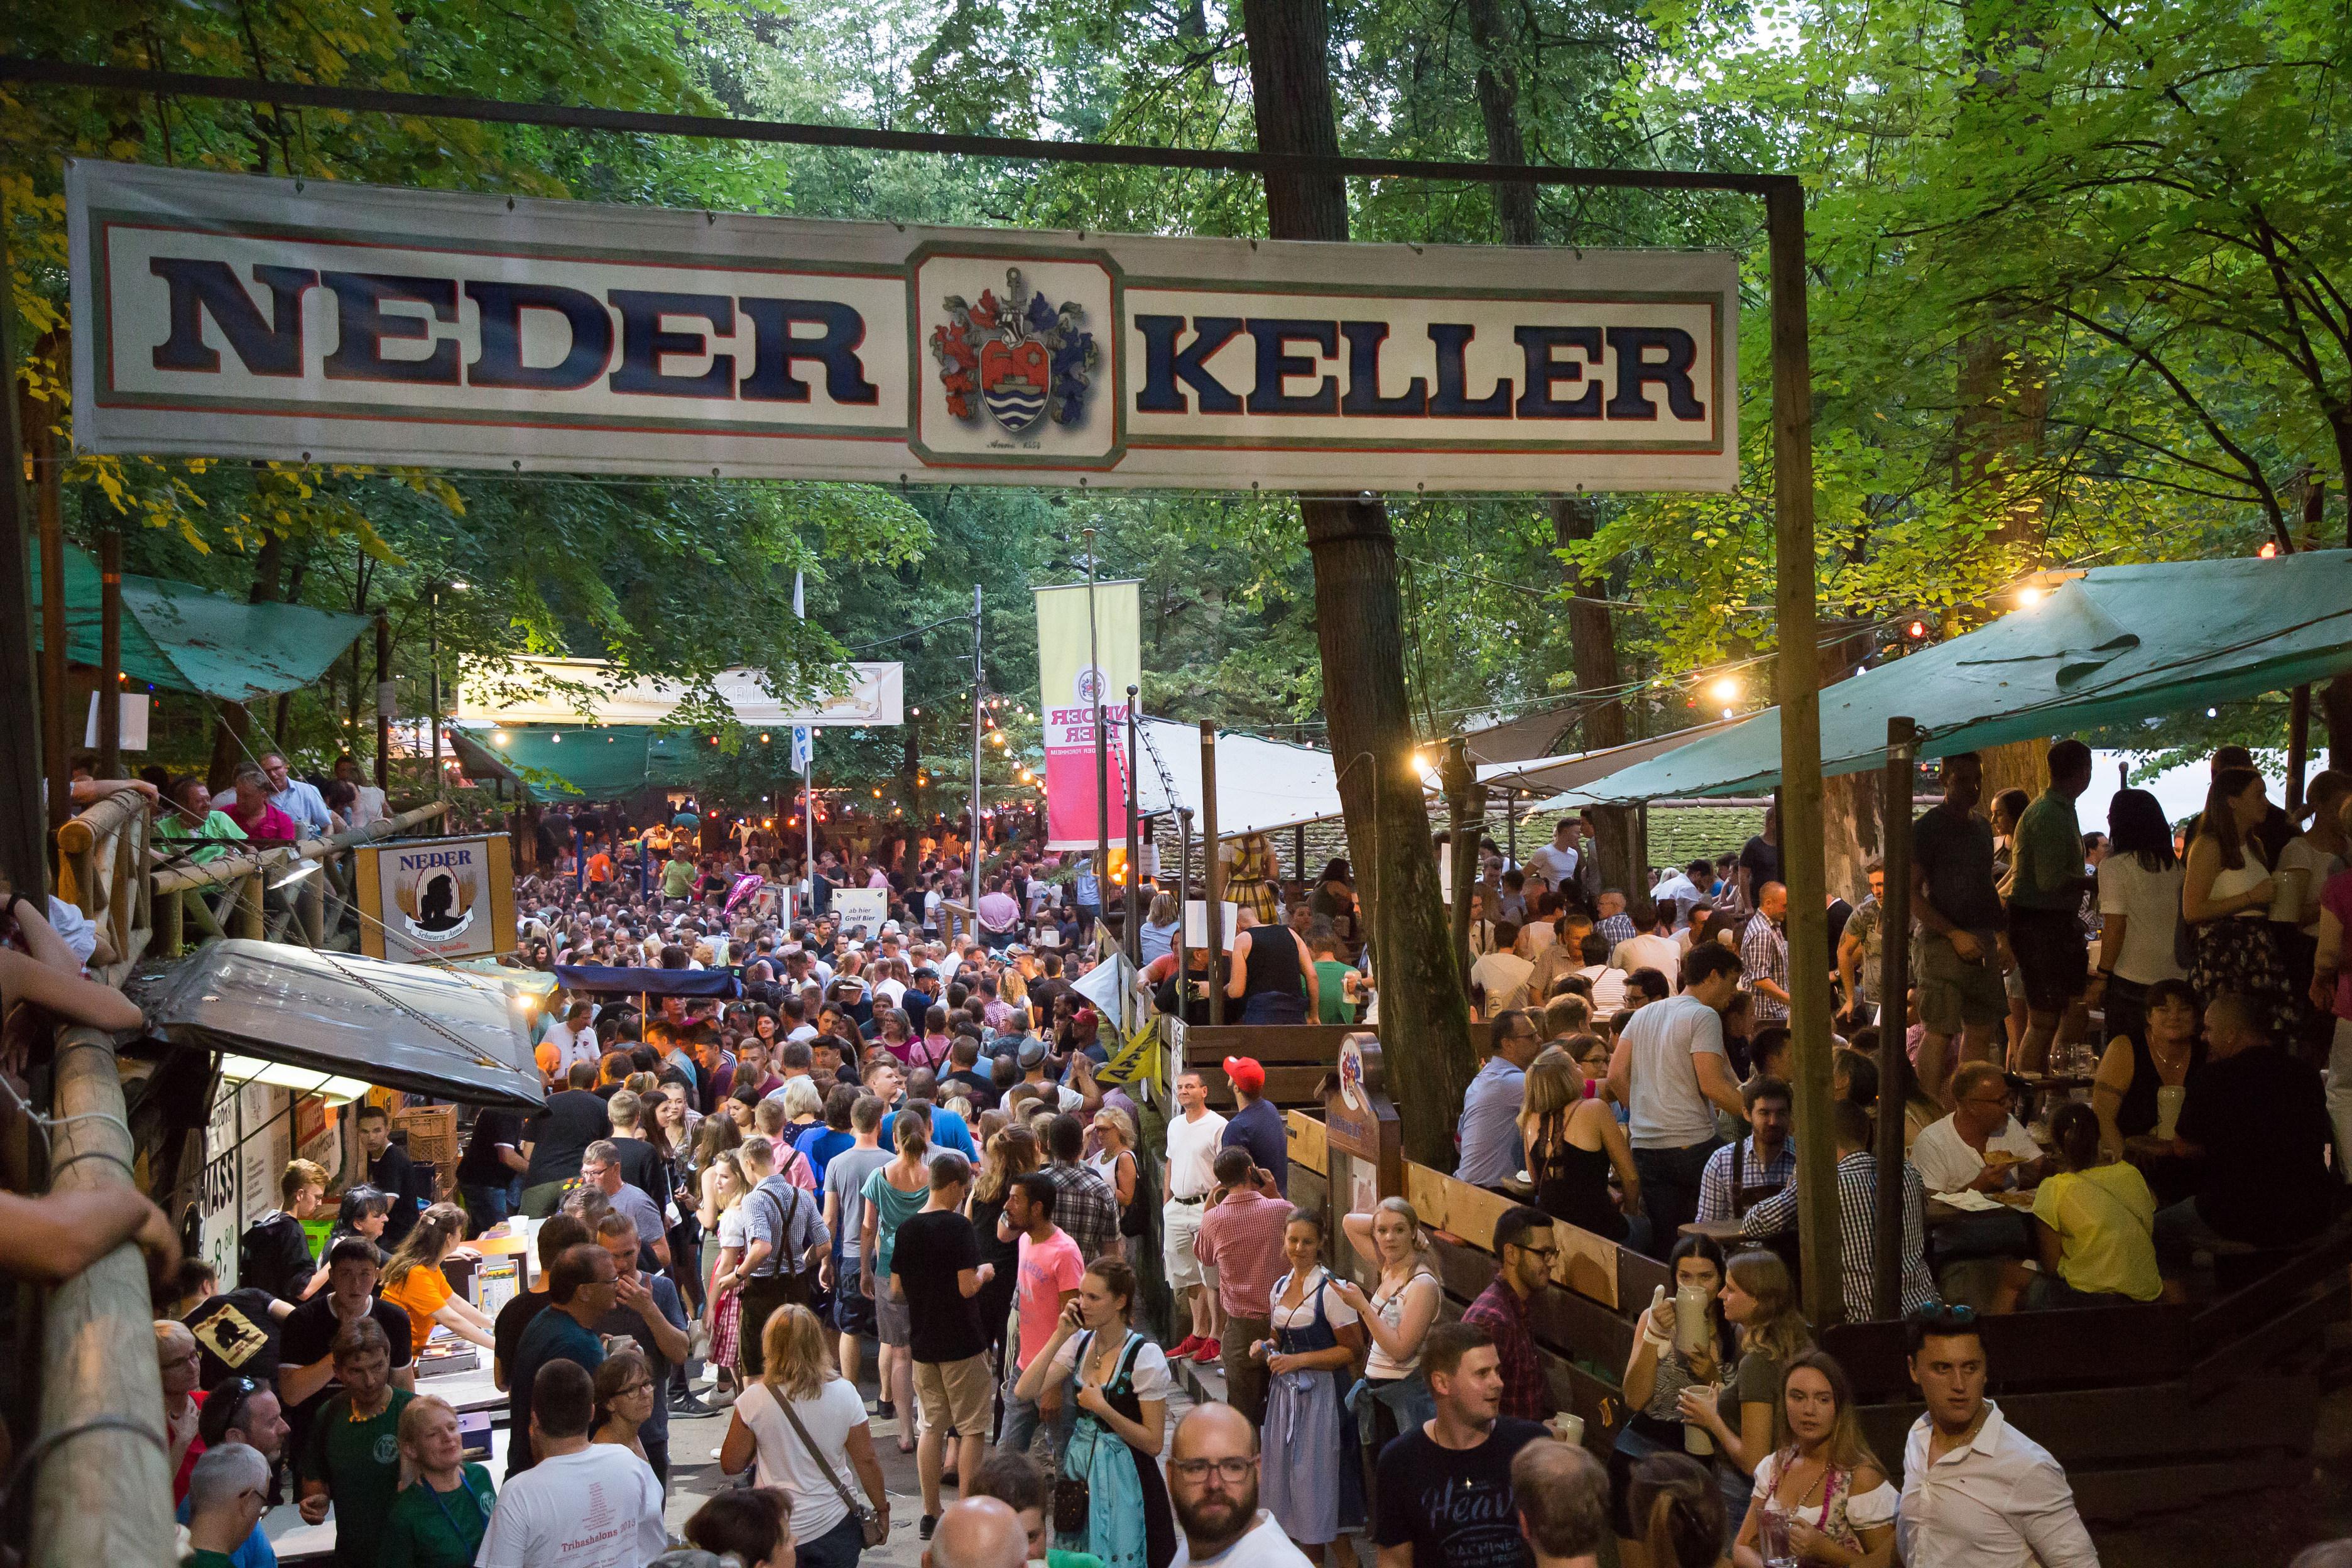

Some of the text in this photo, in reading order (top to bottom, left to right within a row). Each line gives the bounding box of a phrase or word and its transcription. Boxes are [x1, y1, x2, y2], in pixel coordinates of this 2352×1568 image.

[150, 256, 1706, 422] NEDER KELLER
[400, 850, 472, 872] NEDER
[416, 926, 463, 941] Schwarze Anna
